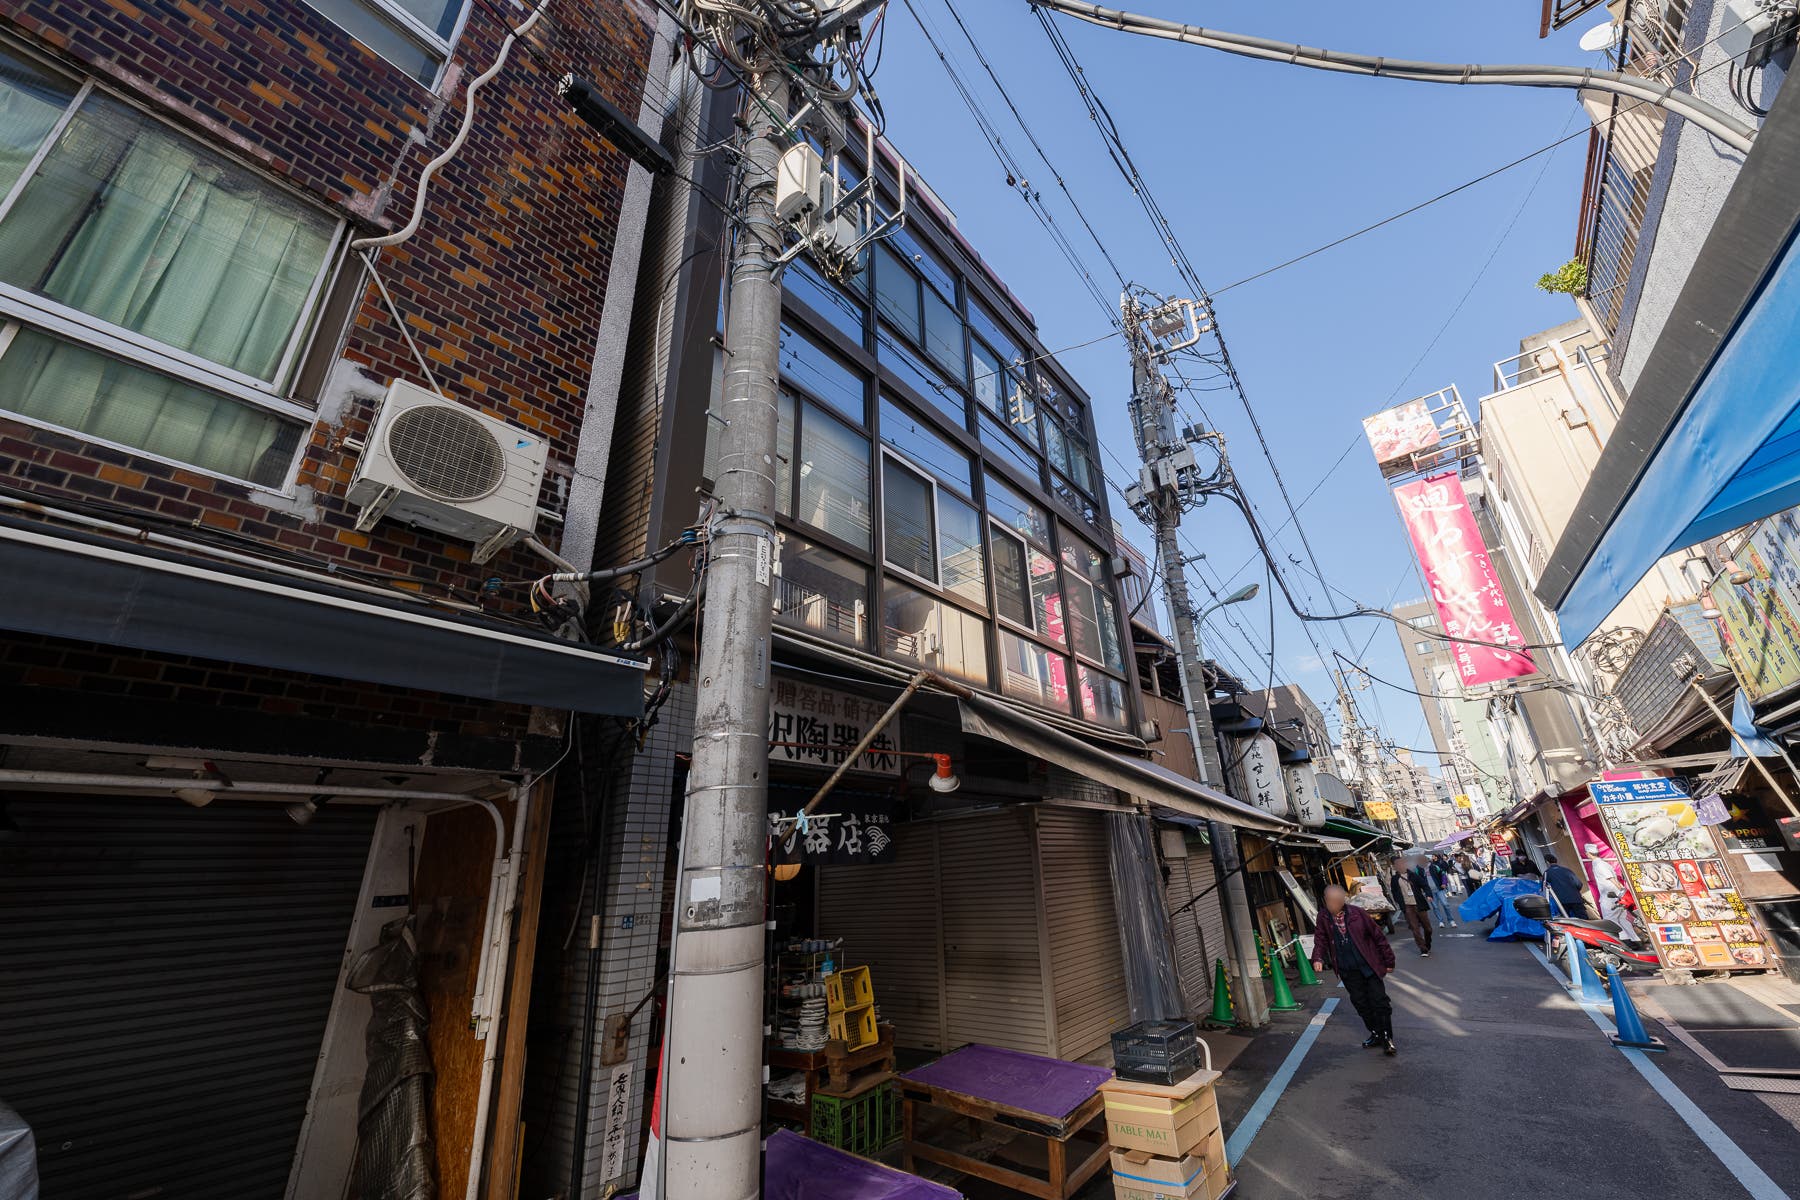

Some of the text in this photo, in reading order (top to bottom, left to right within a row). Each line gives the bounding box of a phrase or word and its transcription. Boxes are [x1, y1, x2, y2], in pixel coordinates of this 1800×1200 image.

[1602, 792, 1635, 803] カキ小屋
[1720, 827, 1769, 839] SAPPO
[1113, 1123, 1168, 1141] TABLE MAT
